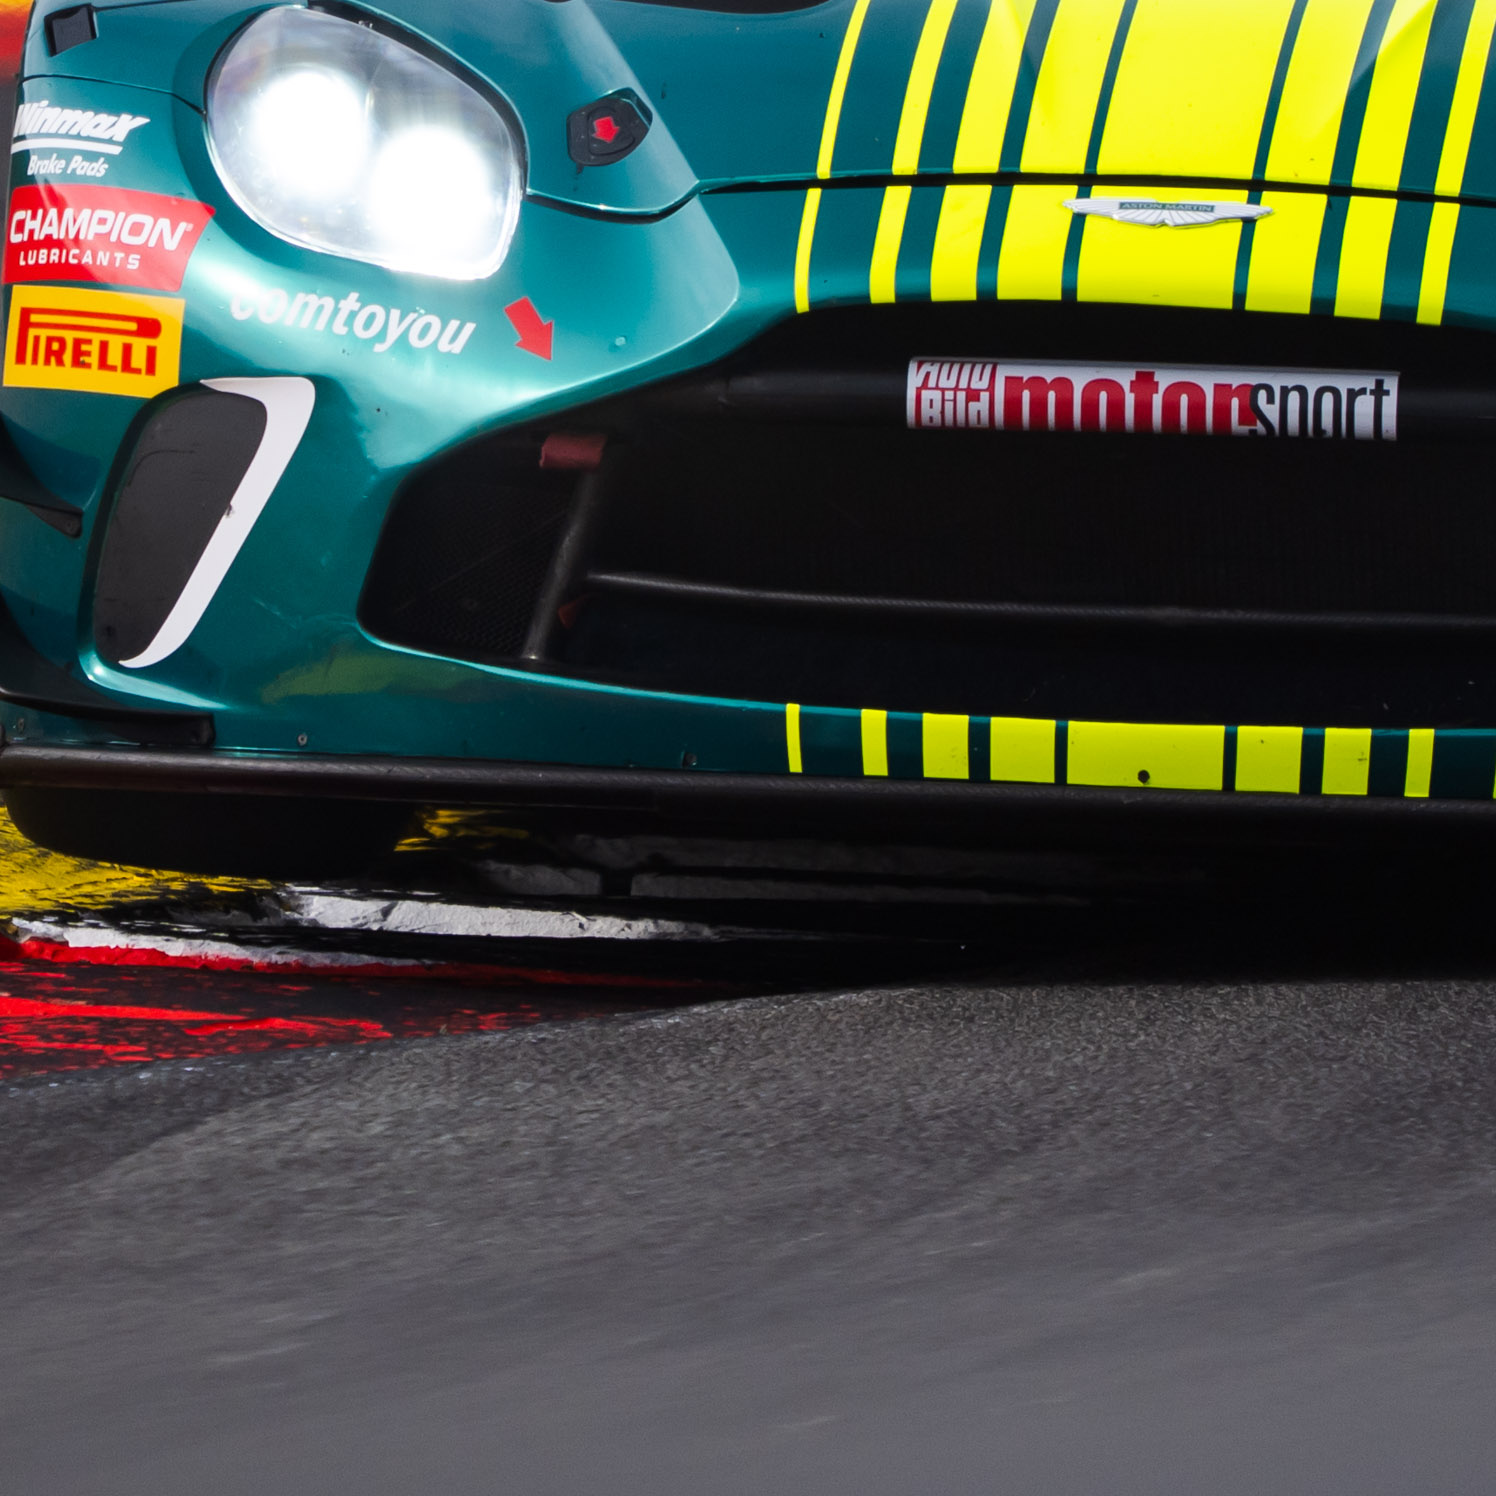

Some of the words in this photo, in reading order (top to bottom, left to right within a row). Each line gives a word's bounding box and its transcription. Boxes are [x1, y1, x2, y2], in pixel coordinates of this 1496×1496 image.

[27, 153, 66, 176] Brake
[67, 154, 110, 178] Pads
[1122, 202, 1163, 210] ASTON
[1165, 203, 1213, 212] MARTIN
[10, 207, 186, 252] CHAMPION
[18, 248, 142, 270] LUBRICANTS
[15, 306, 162, 376] PIRELLI
[229, 286, 478, 355] comtoyou
[920, 388, 991, 428] Bild
[1004, 370, 1391, 438] motorsport
